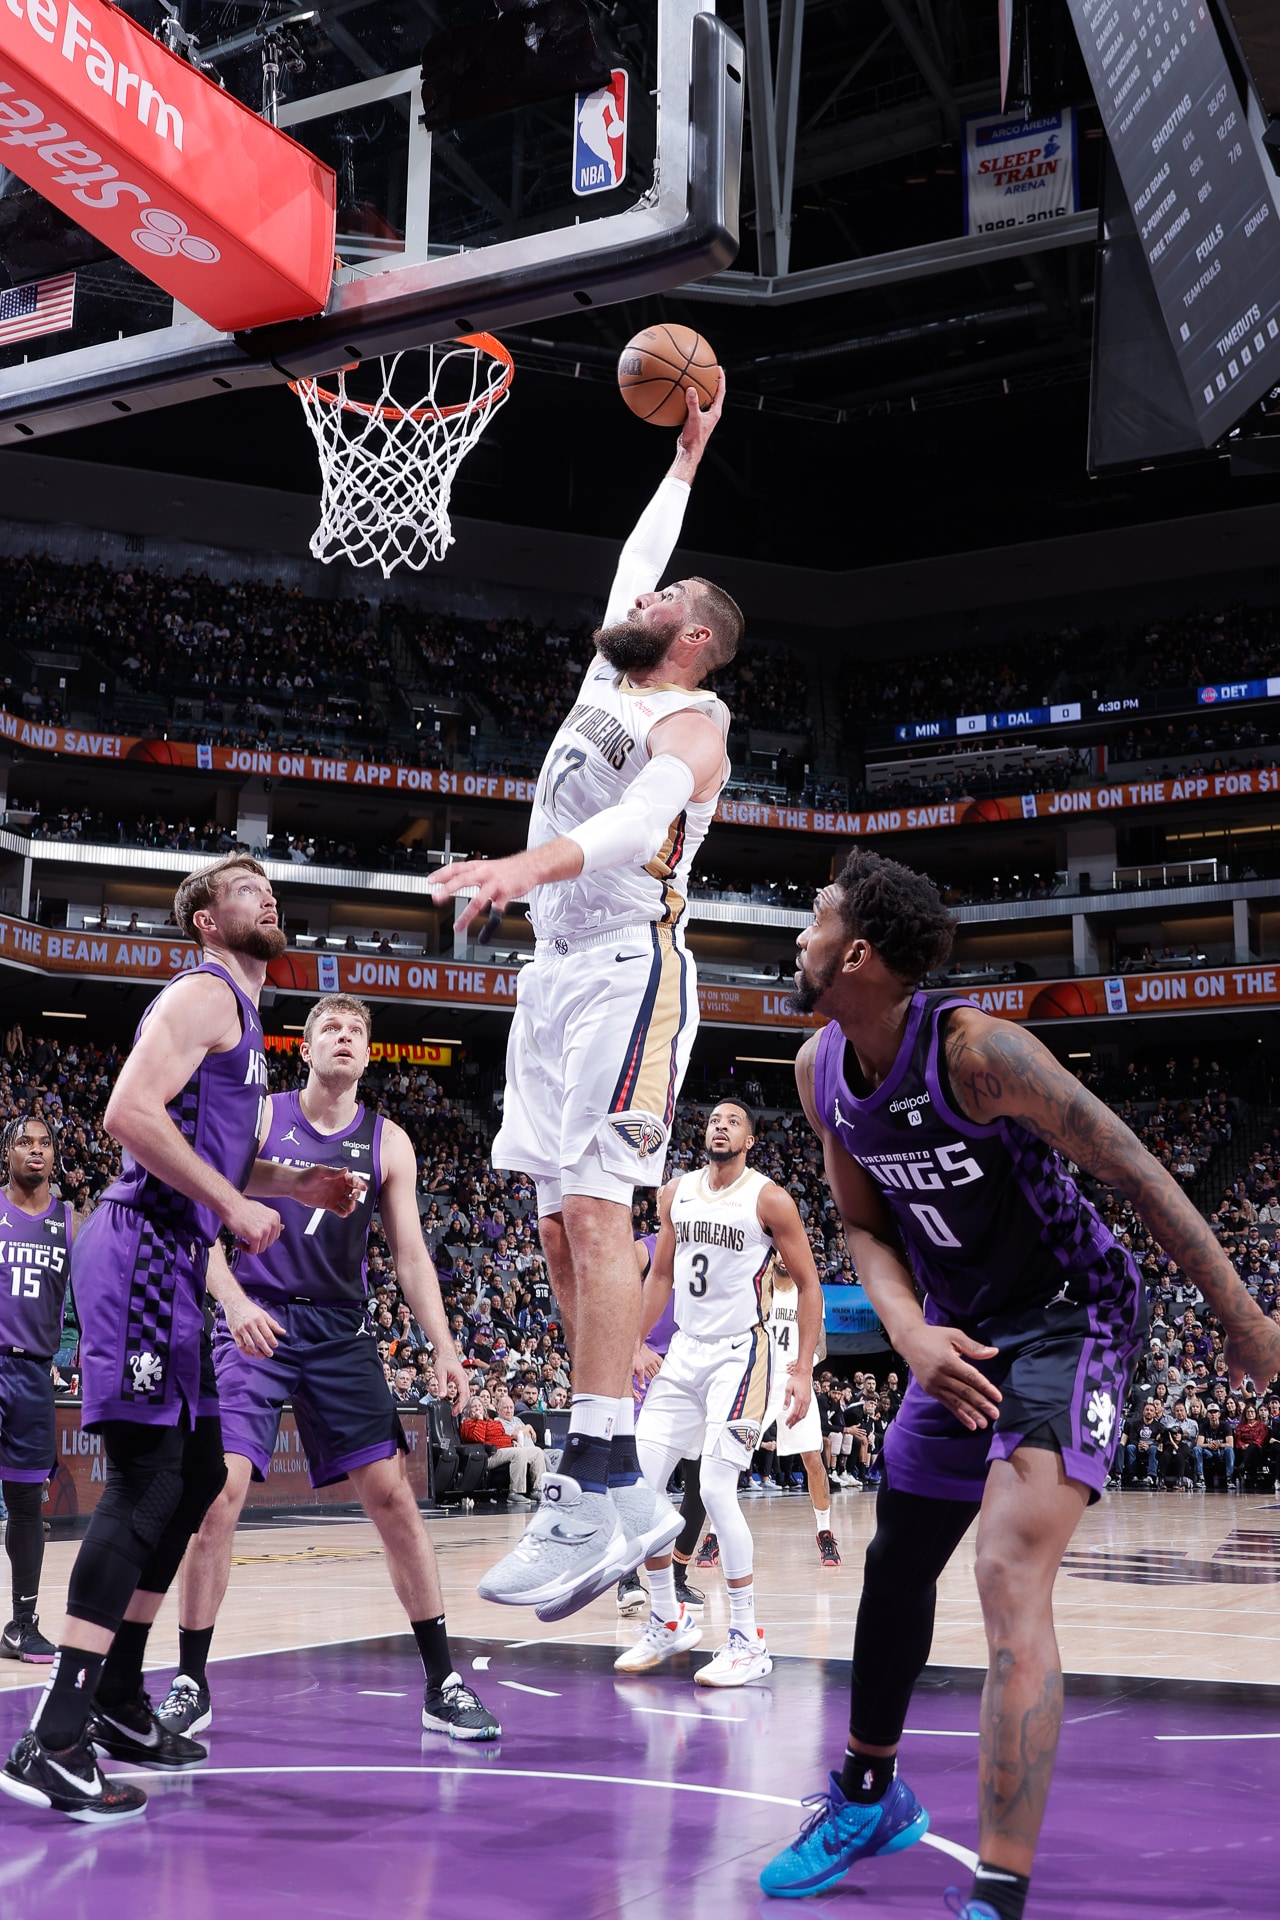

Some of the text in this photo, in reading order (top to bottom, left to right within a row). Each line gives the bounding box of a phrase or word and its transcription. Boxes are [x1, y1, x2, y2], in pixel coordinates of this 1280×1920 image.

[1095, 10, 1120, 51] DANIELS
[1102, 31, 1124, 71] INGRAM
[1132, 5, 1141, 22] 15
[1139, 24, 1147, 41] 13
[1147, 12, 1156, 28] 12
[1157, 1, 1164, 15] 2
[1113, 64, 1141, 110] HAWKINS
[991, 116, 1058, 139] ARCO ARENA
[1119, 107, 1134, 135] TEAM
[1132, 85, 1151, 117] TOTALS
[1152, 93, 1192, 154] SHOOTING
[580, 164, 605, 187] NBA
[977, 148, 1042, 175] SLEEP
[994, 159, 1058, 187] TRAIN
[1141, 189, 1177, 239] 3-POINTERS
[1216, 112, 1237, 142] 12/22
[1003, 179, 1046, 196] ARENA
[1134, 188, 1151, 216] FIELD
[1150, 162, 1171, 195] GOALS
[1149, 237, 1166, 264] FREE
[1164, 207, 1191, 245] THROWS
[1195, 222, 1225, 264] FOULS
[1182, 203, 1270, 308] TEAM FOULS BONUS
[1216, 302, 1261, 357] TIMEOUTS
[1096, 698, 1139, 713] 4:30 PM
[1220, 684, 1248, 699] DET
[576, 708, 636, 771] ORLEANS
[915, 723, 940, 737] MIN
[1007, 712, 1033, 726] DAL
[21, 722, 58, 748] AND
[64, 733, 121, 757] SAVE!
[225, 750, 271, 774] JOIN
[278, 755, 305, 776] ON
[312, 759, 348, 782] THE
[353, 764, 391, 786] APP
[397, 768, 432, 791] FOR
[439, 772, 458, 794] $1
[463, 775, 498, 797] OFF
[503, 780, 536, 801] PER
[541, 743, 587, 812] 17
[722, 769, 1279, 833] LIGHT THE BEAM AND SAVE! JOIN ON THE APP FOR $1
[13, 927, 43, 954] THE
[47, 936, 108, 963] BEAM
[115, 944, 161, 967] AND
[169, 948, 205, 969] SAV
[347, 961, 400, 987] JOIN
[407, 966, 437, 990] ON
[445, 970, 486, 993] THE
[493, 974, 518, 996] AP
[707, 991, 718, 1000] ON
[720, 992, 740, 1003] YOUR
[1135, 977, 1187, 1003] JOIN
[1194, 976, 1225, 997] ON
[1232, 971, 1277, 995] THE
[706, 1002, 732, 1013] VISITS.
[889, 1091, 931, 1113] dialpad
[342, 1140, 370, 1151] dialpad
[861, 1150, 931, 1164] SACRAMENTO
[853, 1141, 985, 1190] INGS
[44, 1218, 65, 1228] dialpad
[693, 1220, 745, 1252] ORLEANS
[909, 1203, 962, 1248] 0
[11, 1266, 42, 1298] 15
[689, 1253, 710, 1298] 3
[775, 1308, 798, 1323] ORLEA
[62, 1430, 103, 1456] LIGH
[273, 1458, 301, 1473] GALLON
